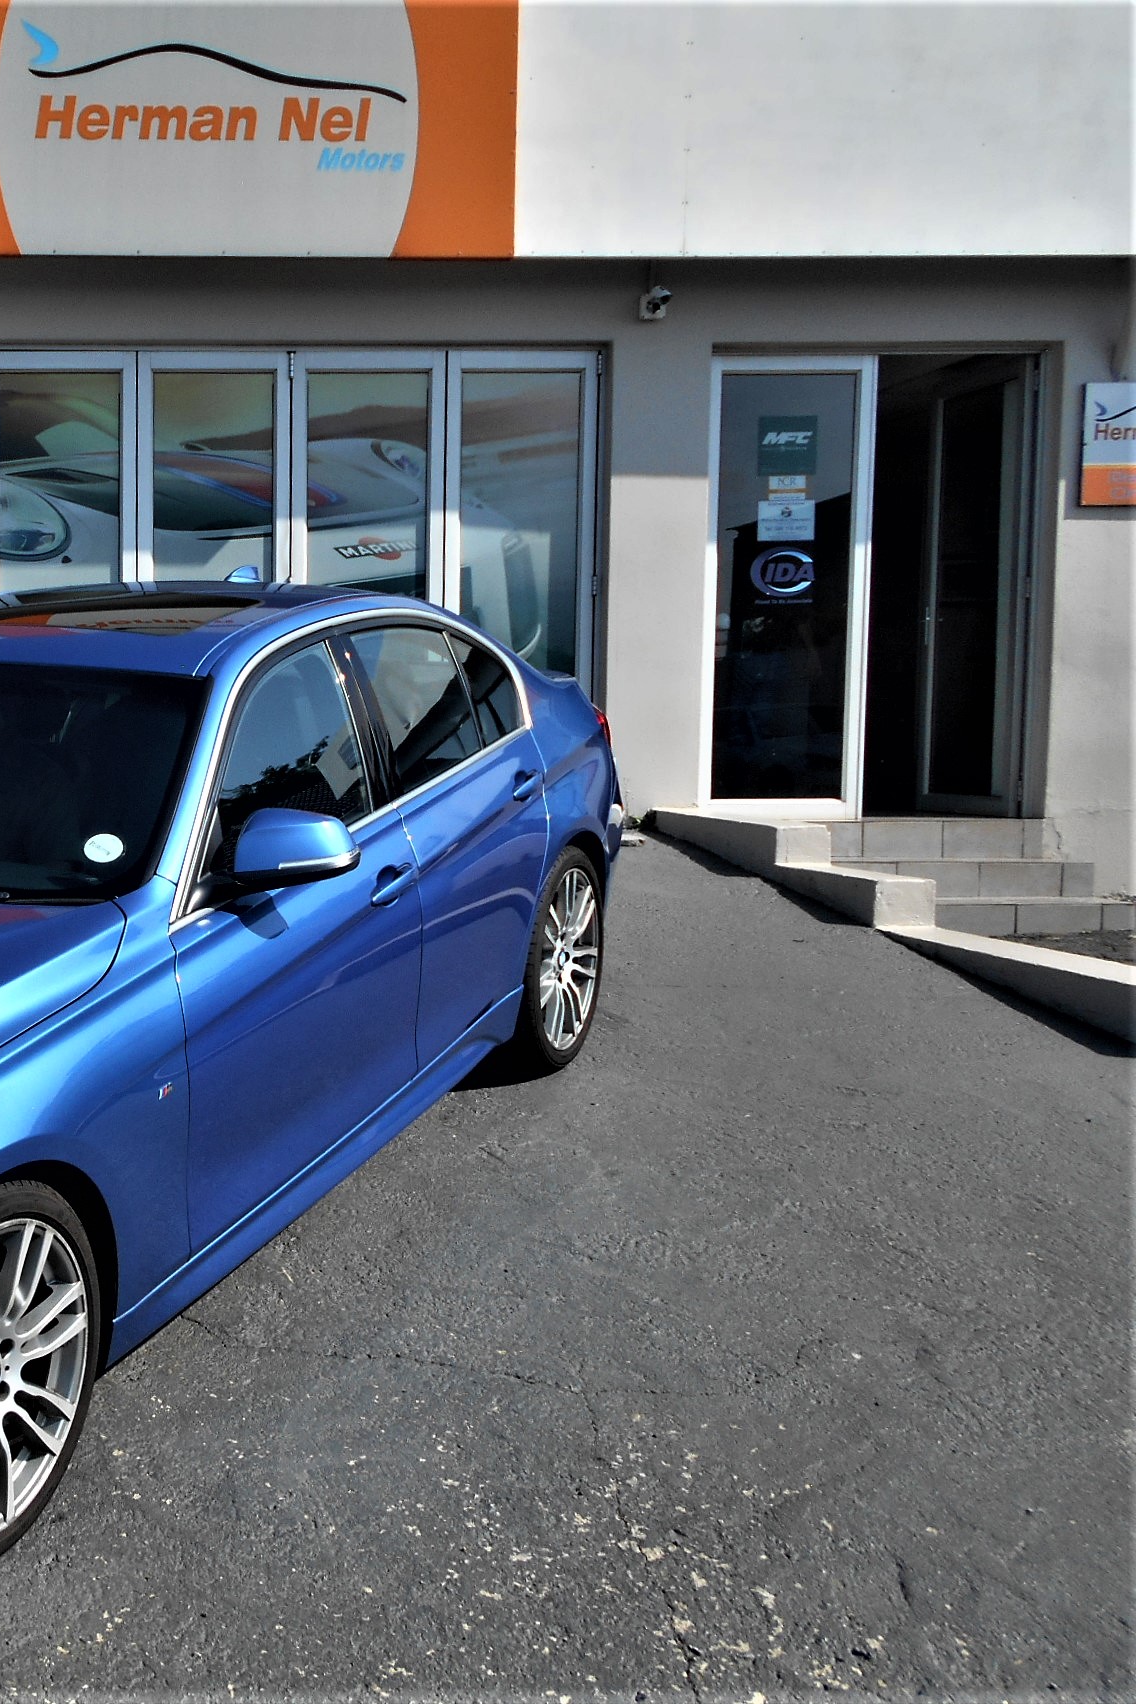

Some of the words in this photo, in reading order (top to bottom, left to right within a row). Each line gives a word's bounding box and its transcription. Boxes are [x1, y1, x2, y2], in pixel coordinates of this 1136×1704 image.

[34, 95, 258, 141] Herman
[278, 96, 373, 142] Nel
[317, 147, 405, 174] Motors
[762, 431, 813, 445] MFC
[338, 540, 417, 557] MARTINI
